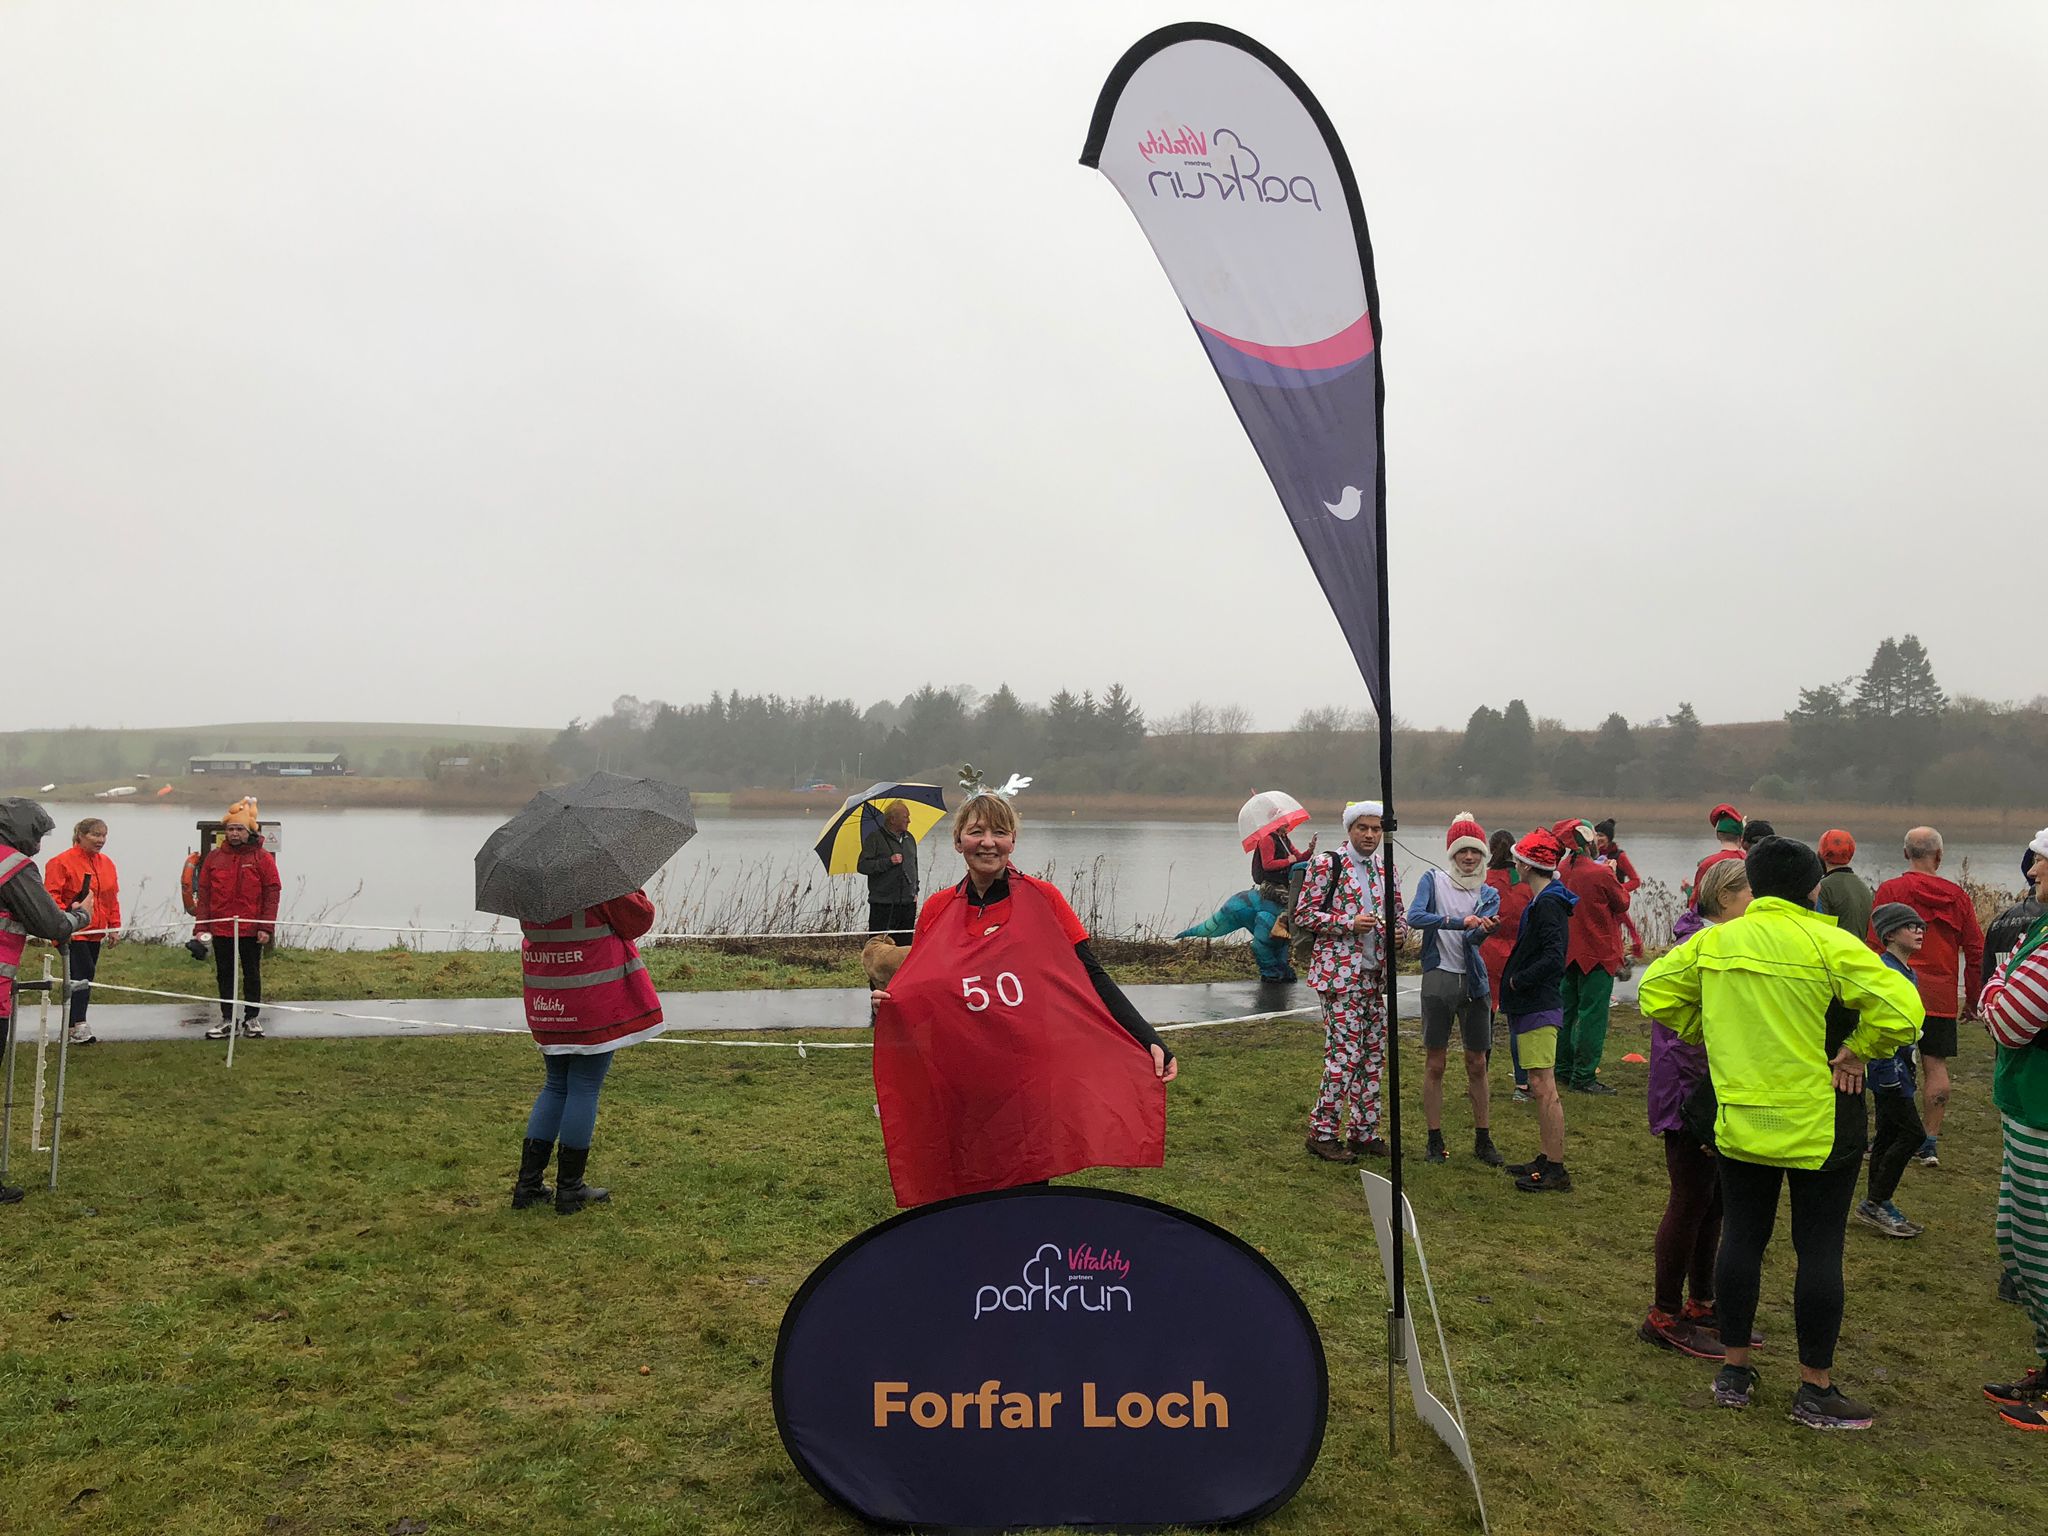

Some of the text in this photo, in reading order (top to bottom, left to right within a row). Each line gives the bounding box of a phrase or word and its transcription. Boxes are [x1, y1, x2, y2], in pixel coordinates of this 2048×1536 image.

[523, 950, 584, 963] OLUNTEER
[533, 994, 564, 1016] Vitality
[961, 971, 1024, 1012] 50
[1068, 1243, 1131, 1280] Vitality
[973, 1258, 1132, 1320] parkrun
[873, 1380, 1230, 1429] Forfar Loch
